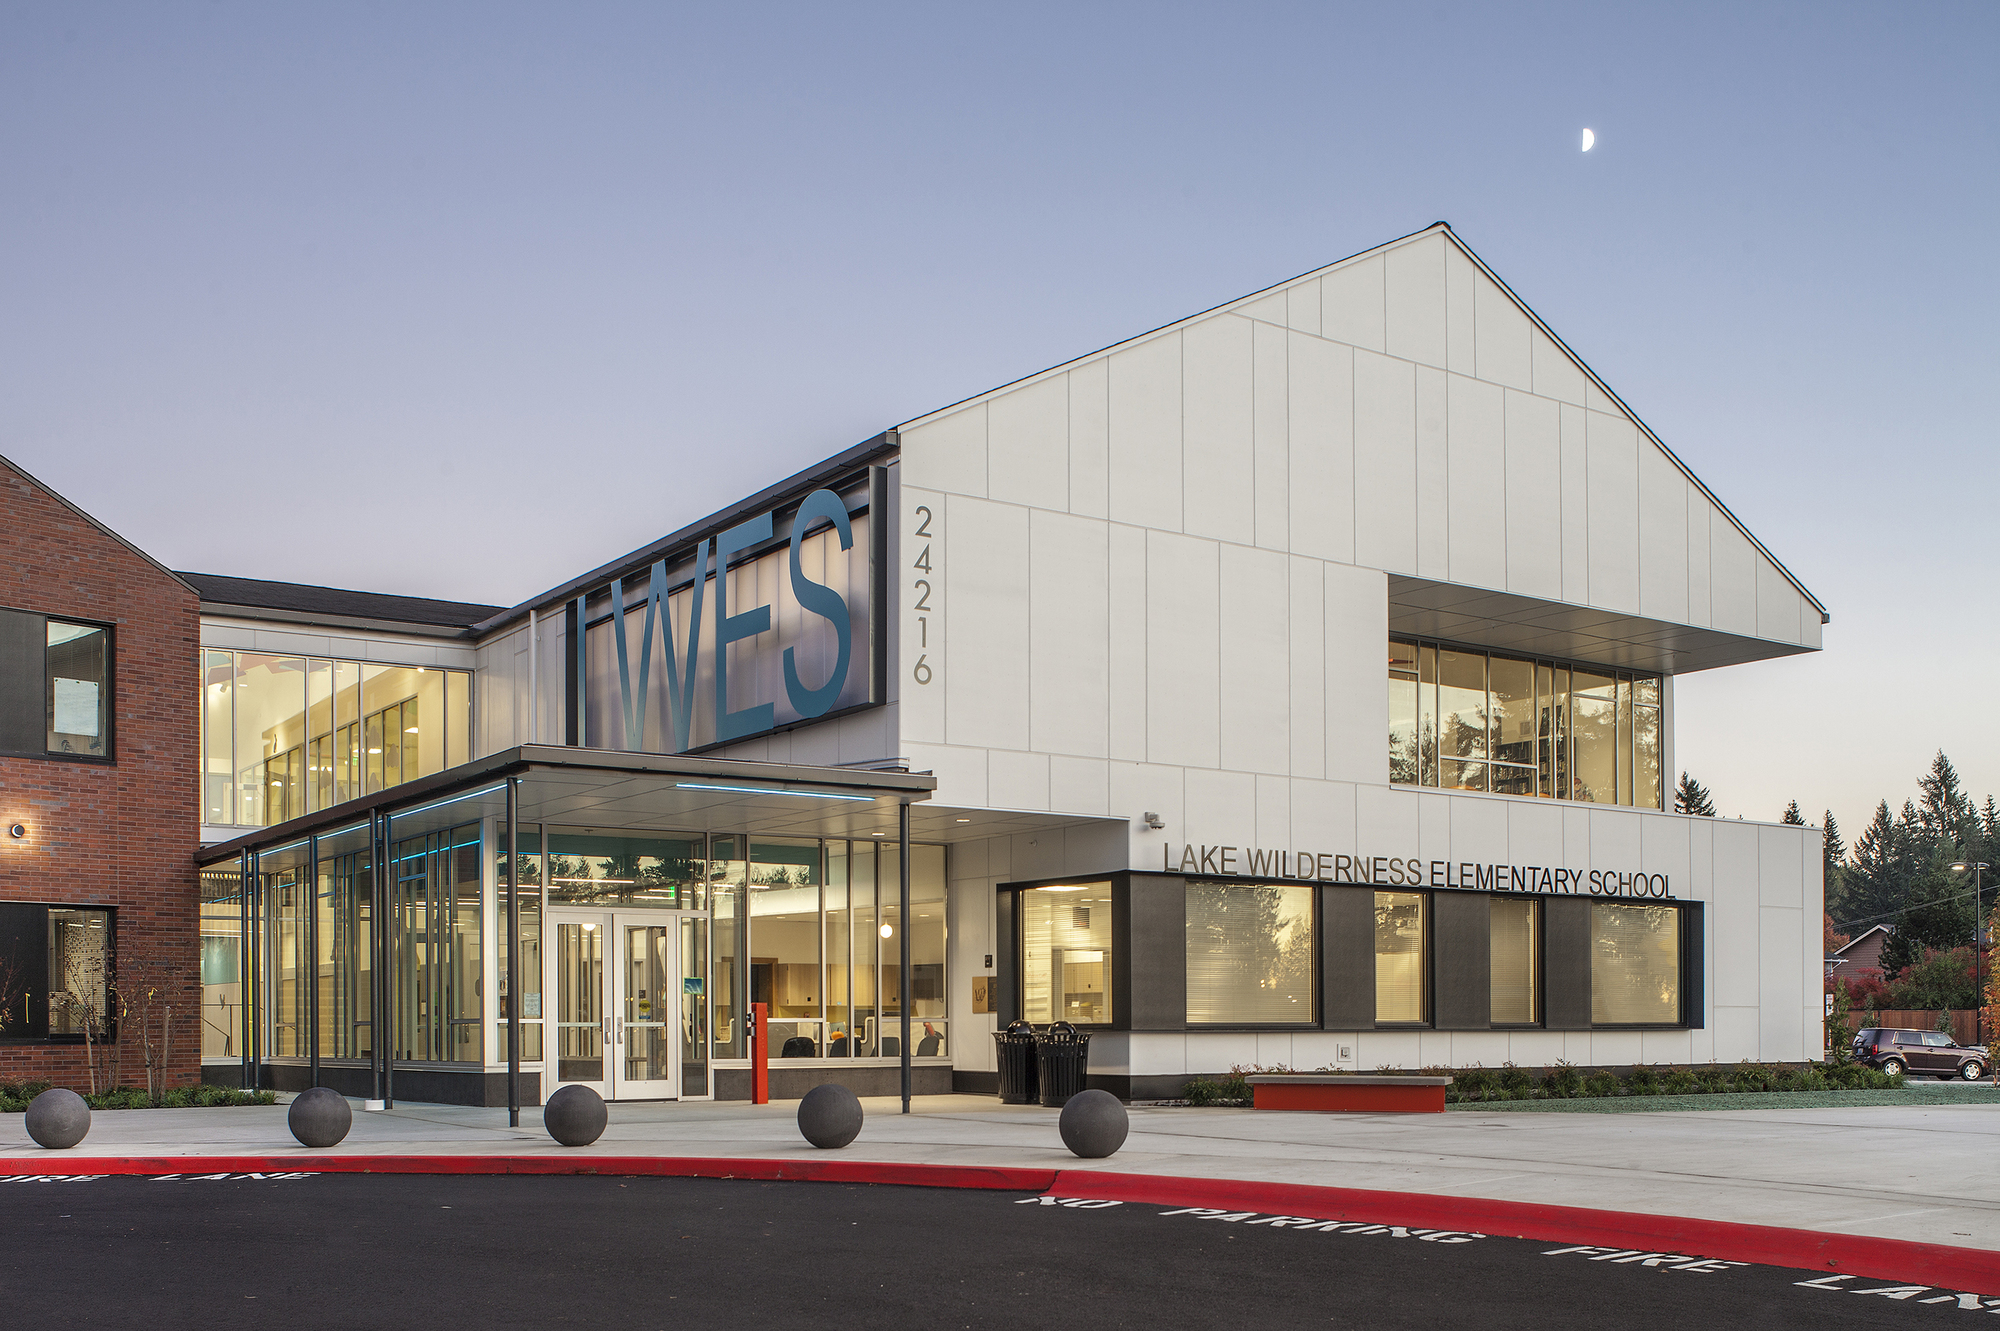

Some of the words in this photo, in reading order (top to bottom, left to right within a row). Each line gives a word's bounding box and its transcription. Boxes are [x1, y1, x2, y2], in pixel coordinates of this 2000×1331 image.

[913, 505, 933, 686] 24216
[1163, 842, 1238, 876] LAKE
[1246, 847, 1423, 886] WILDERNESS
[1430, 860, 1584, 894] ELEMENTARY
[1588, 869, 1677, 899] SCHOOL
[0, 1174, 110, 1183] IRE
[148, 1172, 322, 1181] LANE
[1014, 1196, 1124, 1209] NO
[1158, 1207, 1487, 1243] PARKING
[1540, 1246, 1751, 1273] FIRE
[1792, 1274, 2000, 1314] LAN
